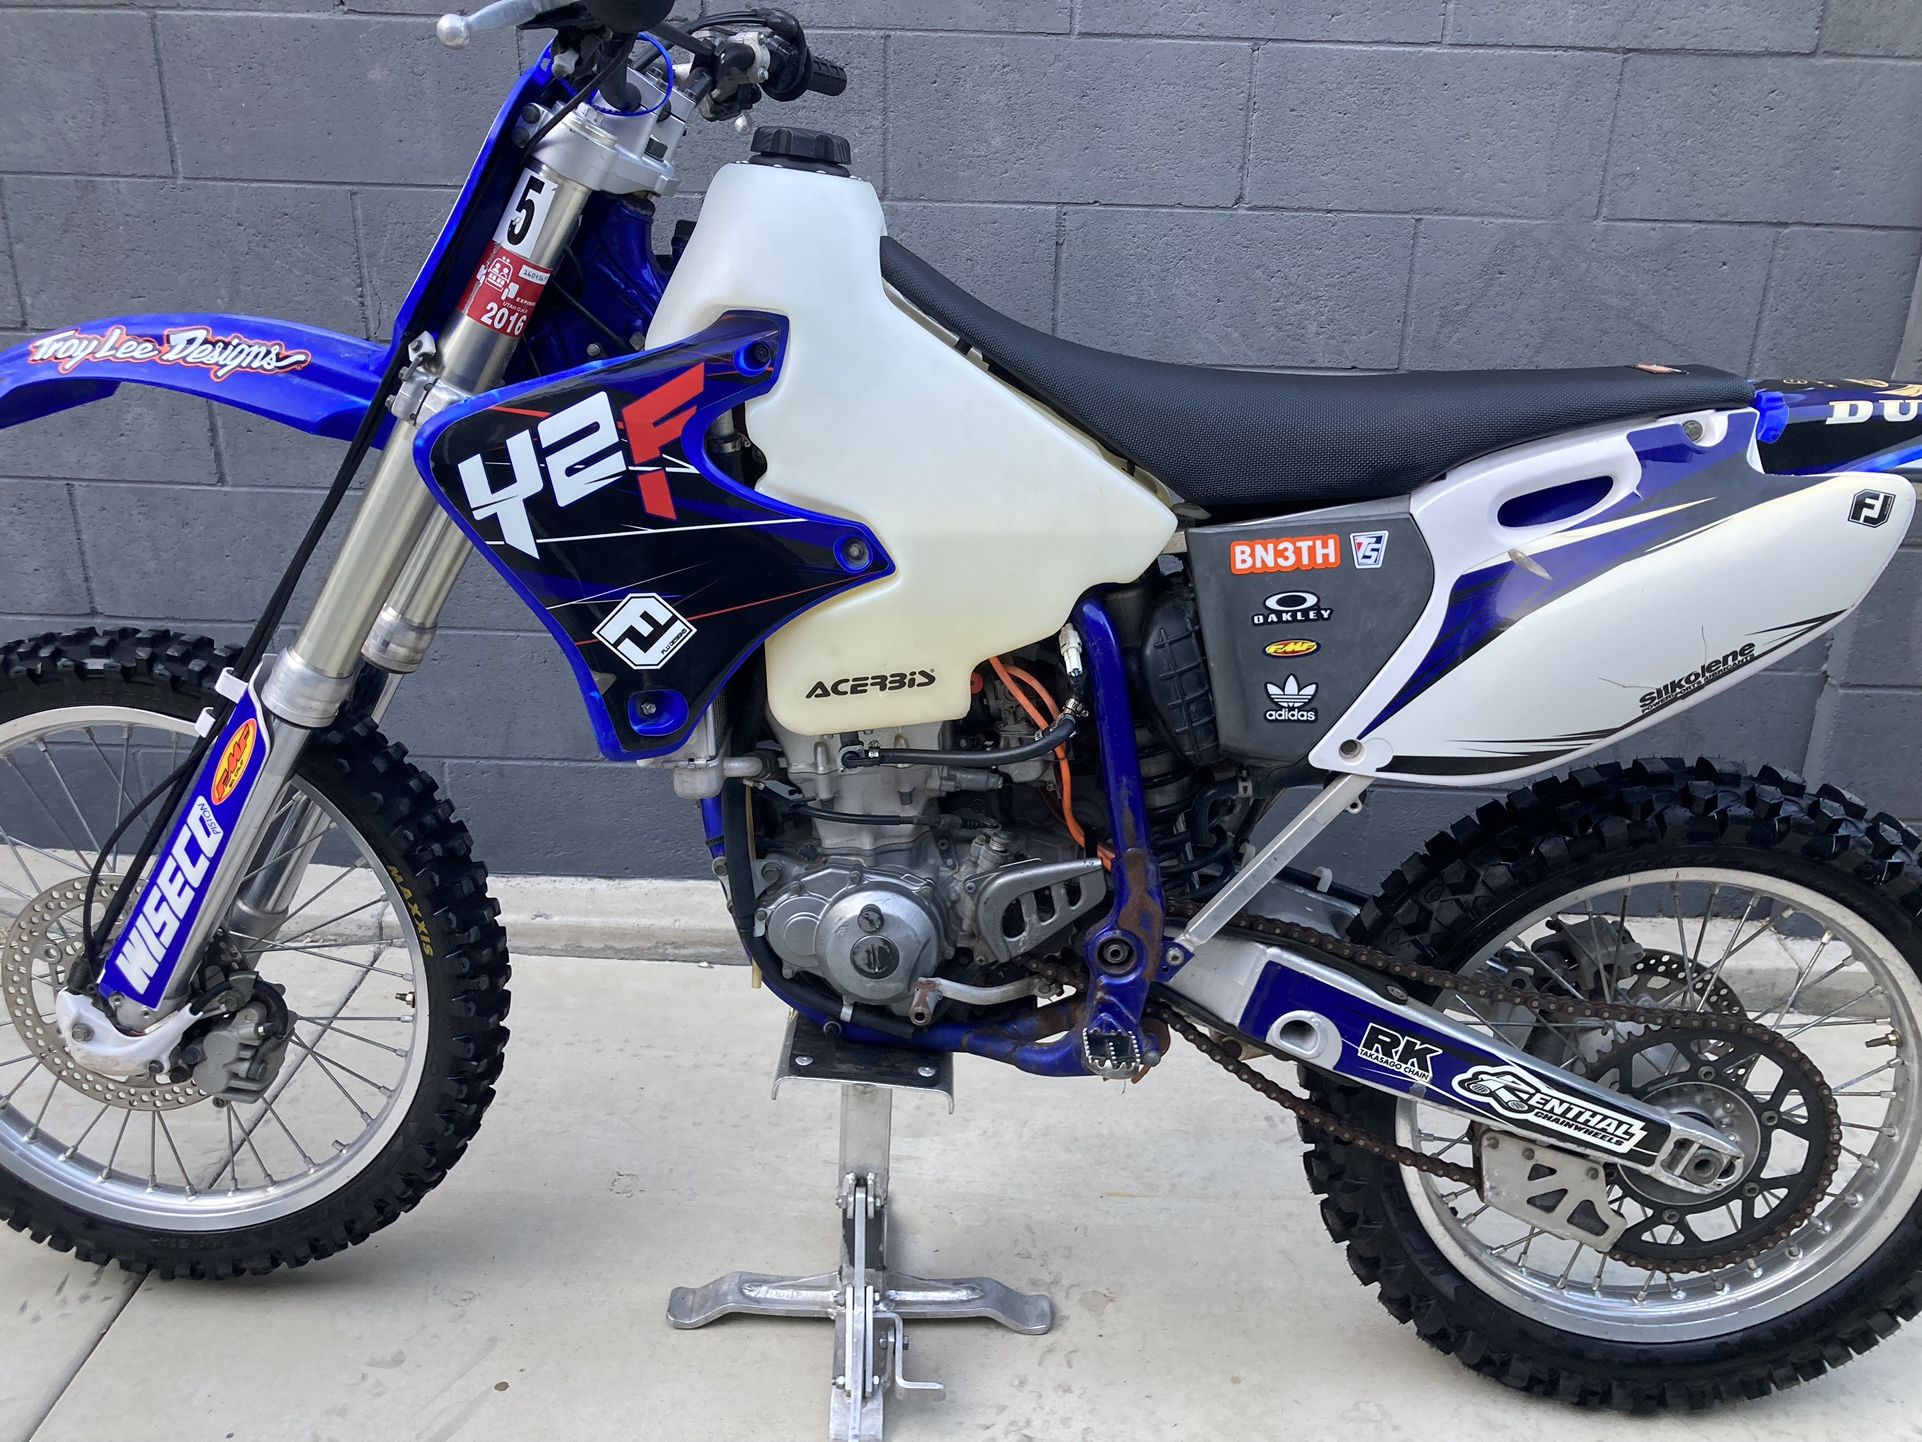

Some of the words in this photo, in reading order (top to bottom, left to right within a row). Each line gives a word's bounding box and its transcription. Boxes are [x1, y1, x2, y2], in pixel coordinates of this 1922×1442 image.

[507, 175, 545, 246] 5
[481, 302, 527, 335] 2016
[31, 330, 98, 369] Troy
[96, 328, 159, 359] Lee
[163, 329, 306, 377] Designs
[1235, 538, 1336, 570] BN3TH
[1253, 609, 1332, 625] OAKLEY
[1265, 640, 1318, 656] FMF
[1265, 708, 1316, 721] adidas
[216, 723, 250, 801] FMF
[198, 802, 222, 836] PISTON
[115, 795, 224, 995] WISECO
[386, 864, 434, 957] MAXXIS
[1359, 1048, 1403, 1071] TAKASAGO
[1403, 1065, 1430, 1081] CHAIN
[1360, 1023, 1442, 1075] RK
[1464, 1070, 1636, 1140] RENTHAL
[1533, 1110, 1625, 1148] CHAINWHEELS
